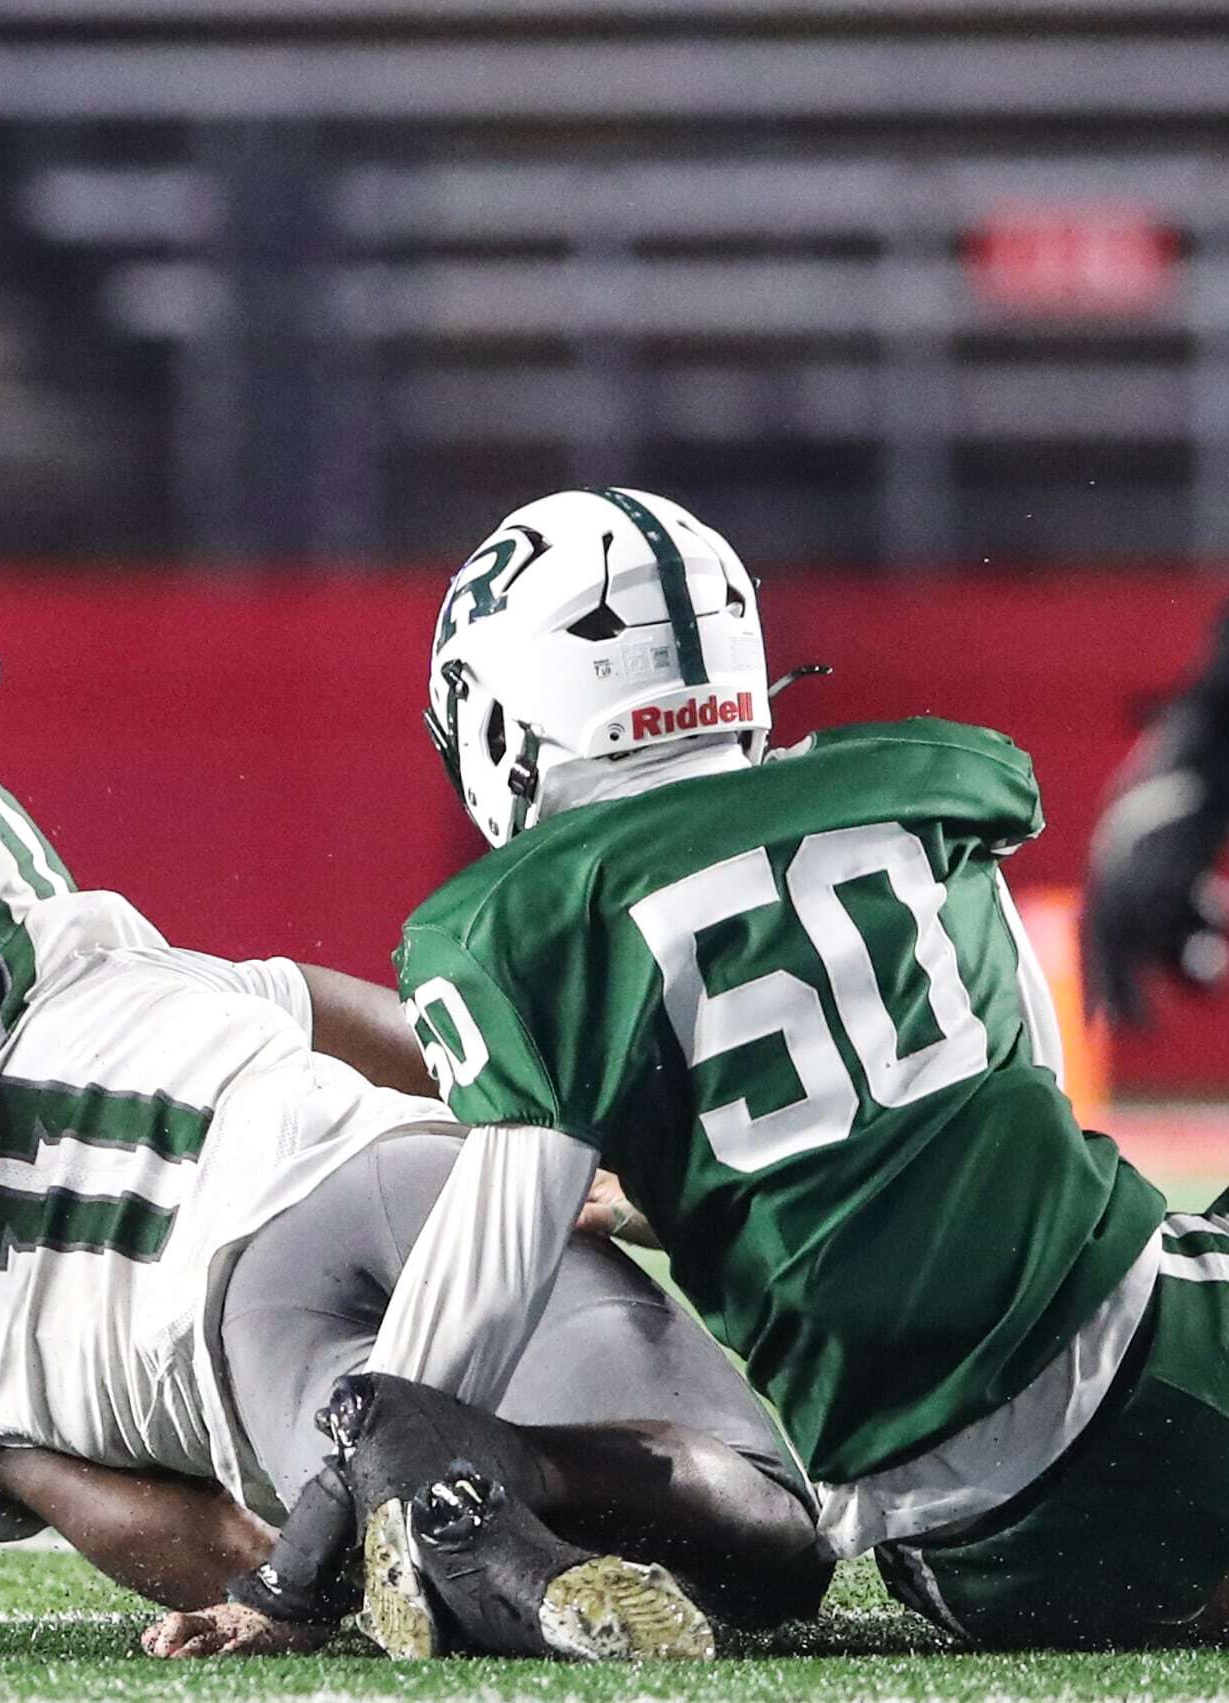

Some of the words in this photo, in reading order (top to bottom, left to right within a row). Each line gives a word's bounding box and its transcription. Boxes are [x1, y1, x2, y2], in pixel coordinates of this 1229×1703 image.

[436, 539, 508, 656] R
[632, 692, 753, 741] Riddell
[405, 976, 489, 1105] 50
[628, 821, 988, 1174] 50
